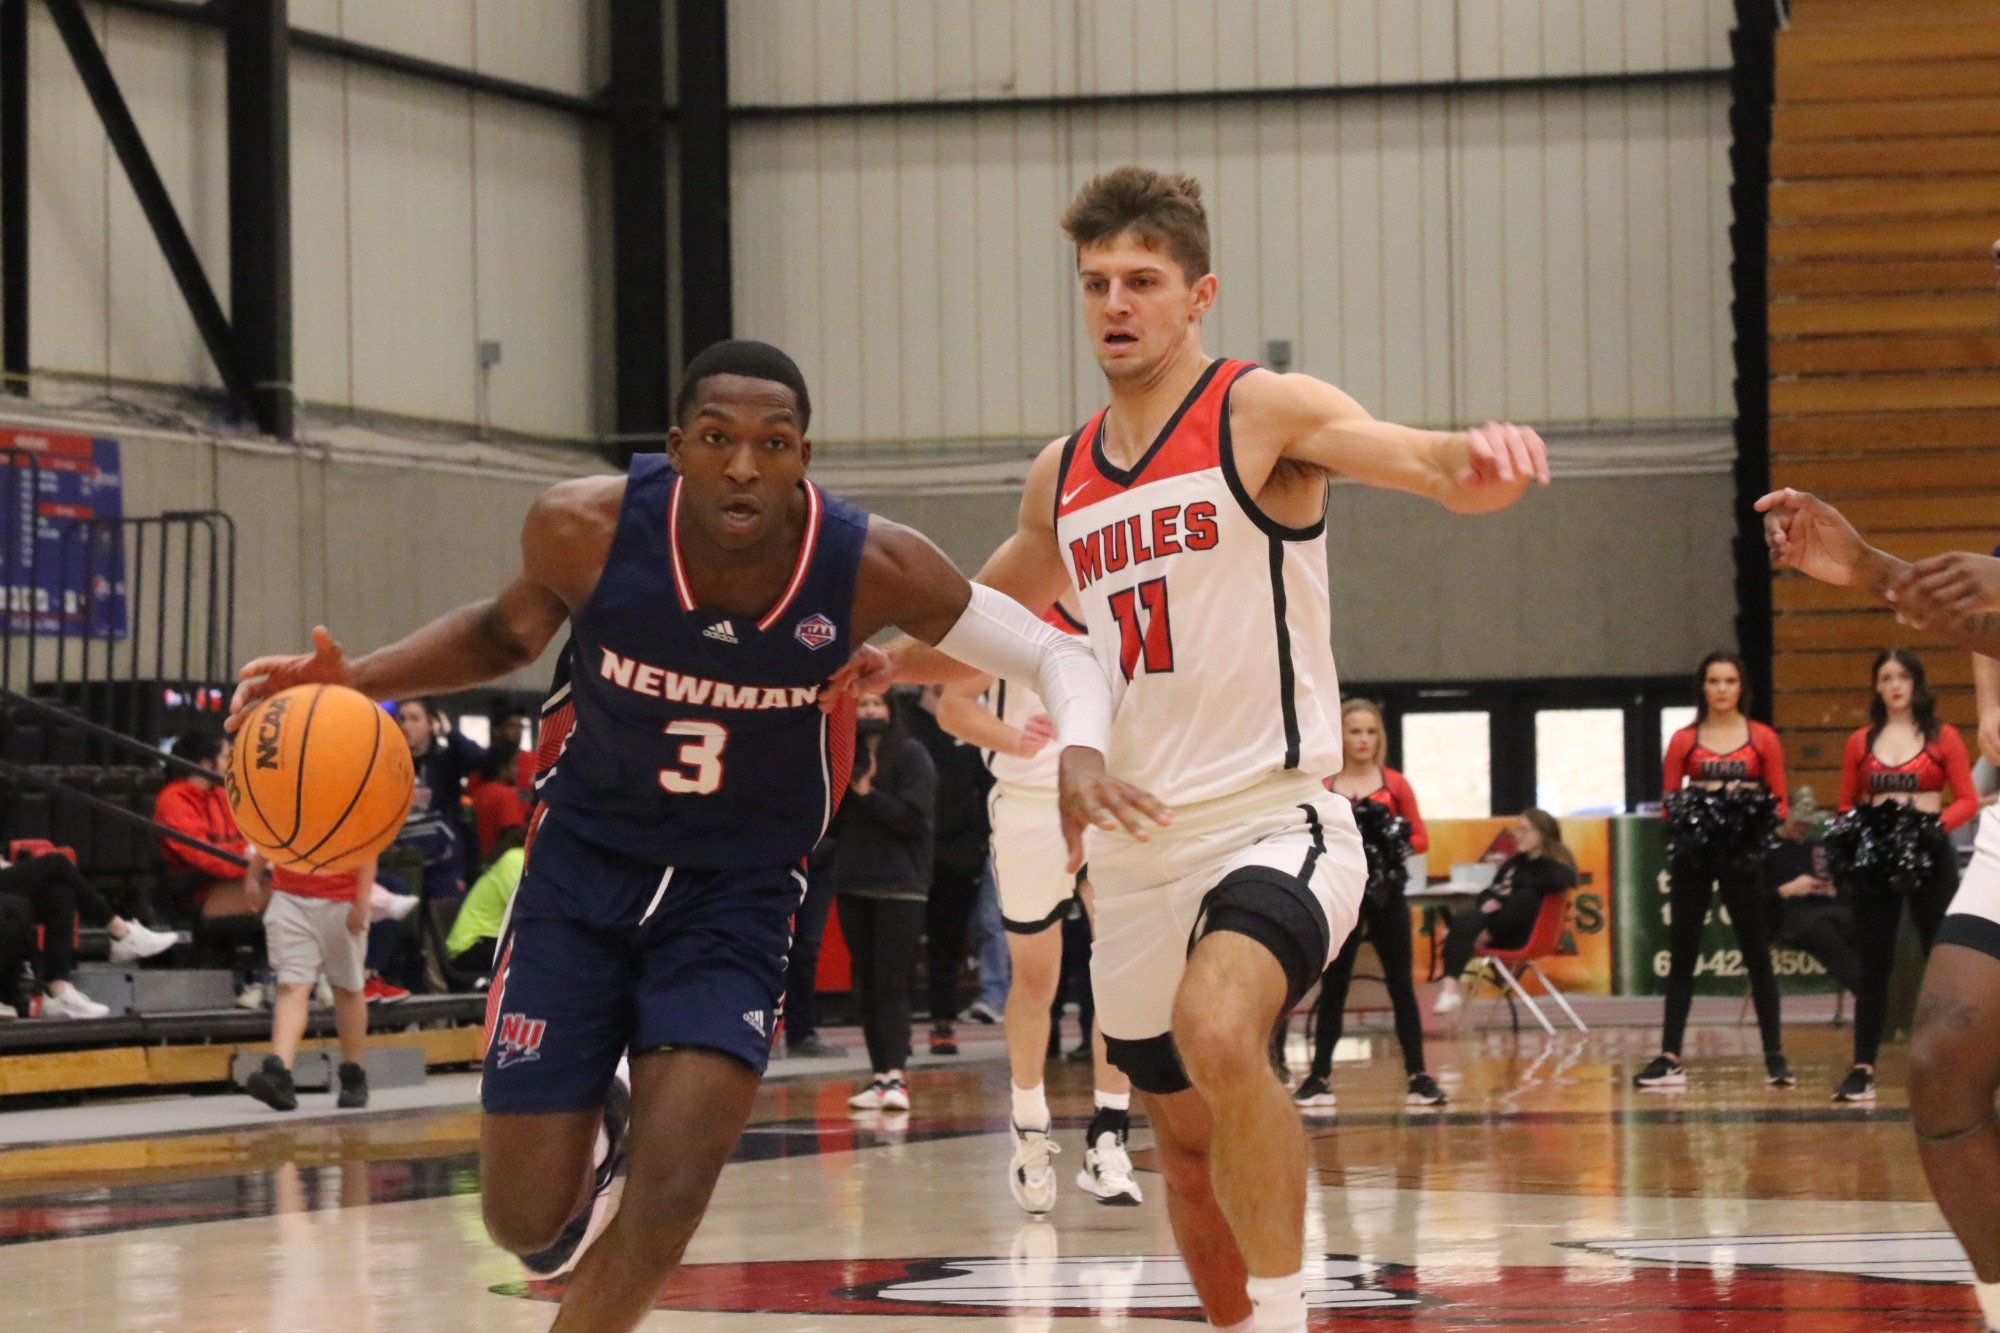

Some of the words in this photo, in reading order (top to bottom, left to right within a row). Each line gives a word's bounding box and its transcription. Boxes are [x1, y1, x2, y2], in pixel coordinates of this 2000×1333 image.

[1069, 501, 1219, 591] MULES
[702, 629, 739, 644] adidas
[1107, 575, 1174, 685] 11
[600, 646, 821, 710] NEWMAN
[256, 697, 288, 770] NCAA
[658, 718, 729, 795] 3
